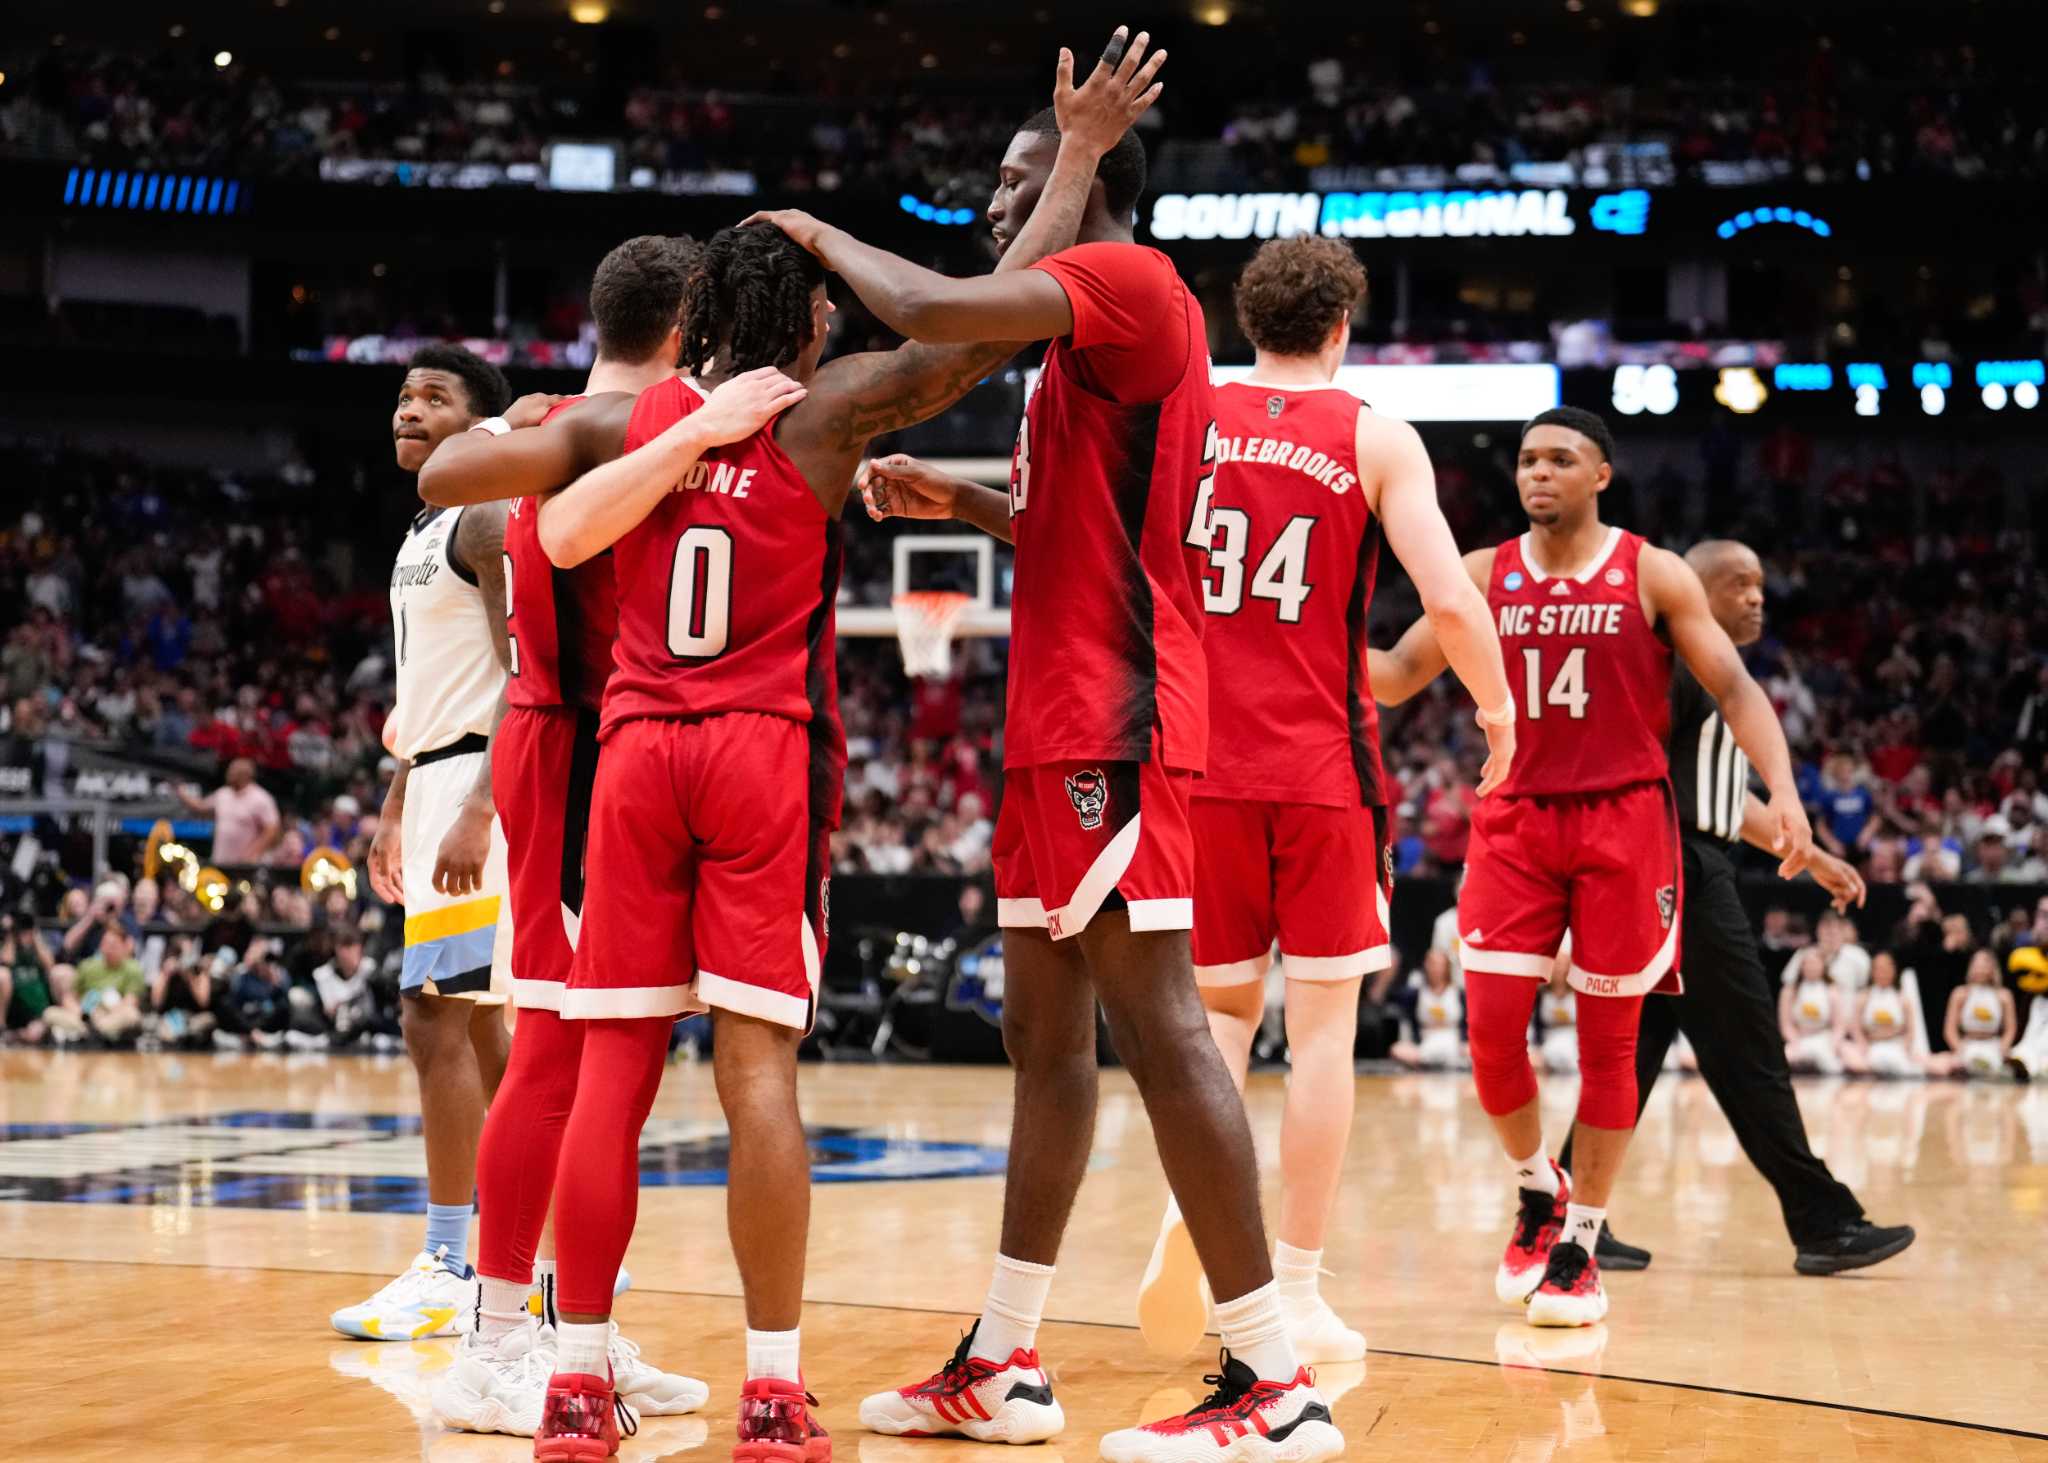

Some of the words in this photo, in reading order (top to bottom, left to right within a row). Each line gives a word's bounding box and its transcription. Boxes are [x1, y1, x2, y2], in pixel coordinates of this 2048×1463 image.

[1150, 193, 1319, 240] SOUTH
[665, 524, 735, 660] 0
[1202, 506, 1319, 624] 34
[1499, 604, 1535, 637] NC
[1536, 603, 1624, 635] STATE
[1521, 647, 1590, 720] 14
[1585, 976, 1621, 994] PACK
